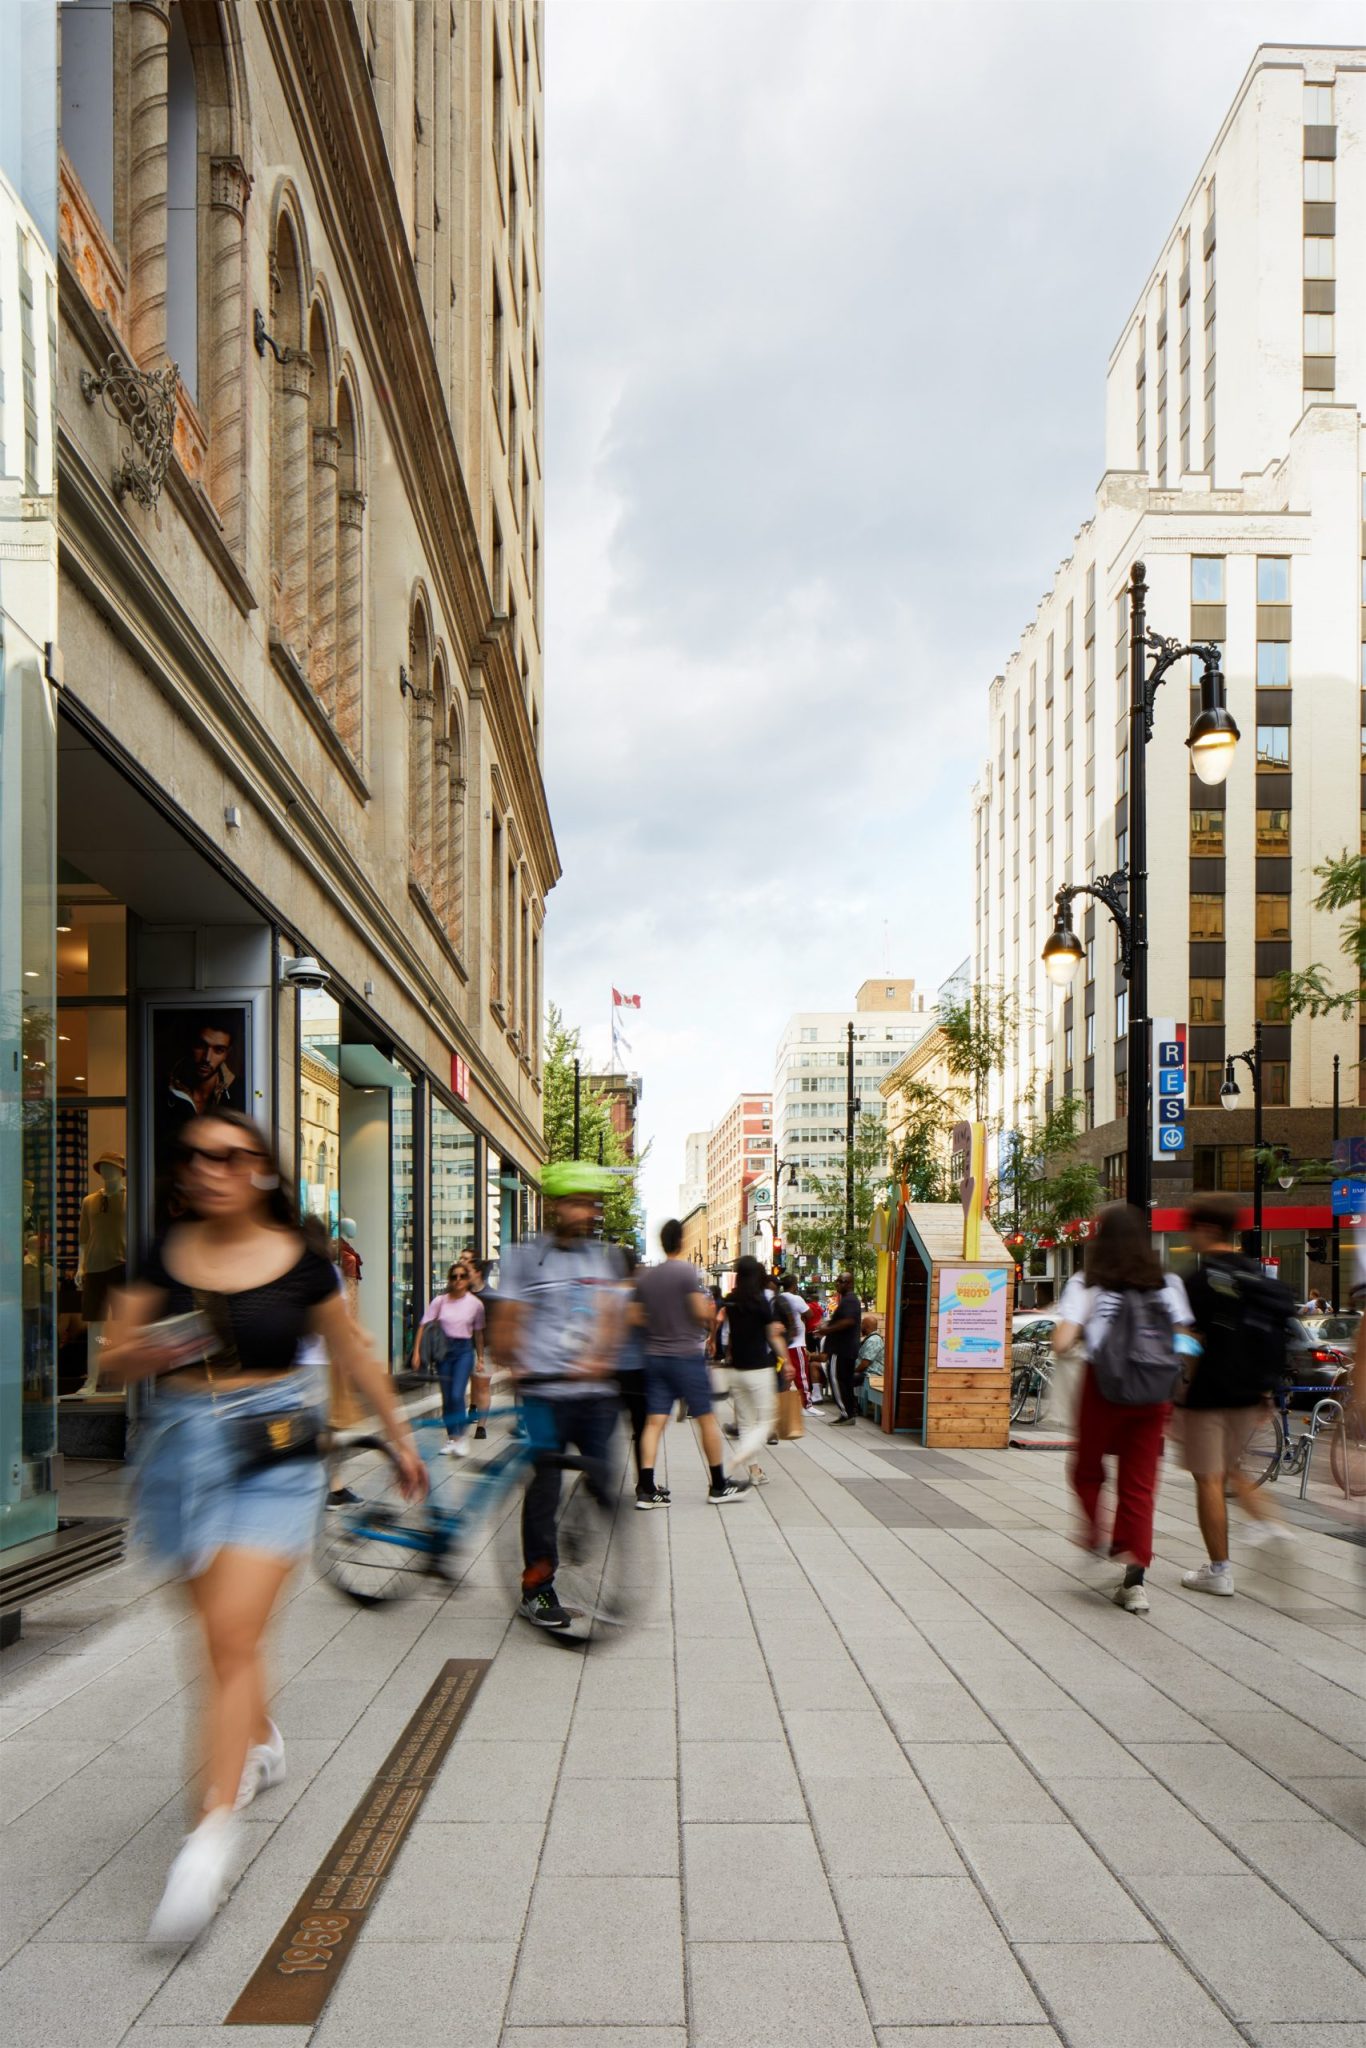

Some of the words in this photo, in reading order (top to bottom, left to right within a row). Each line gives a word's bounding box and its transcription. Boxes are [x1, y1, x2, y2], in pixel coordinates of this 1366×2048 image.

[957, 1287, 990, 1298] PHOTO
[311, 1897, 335, 1909] LE
[277, 1915, 350, 1974] 1958
